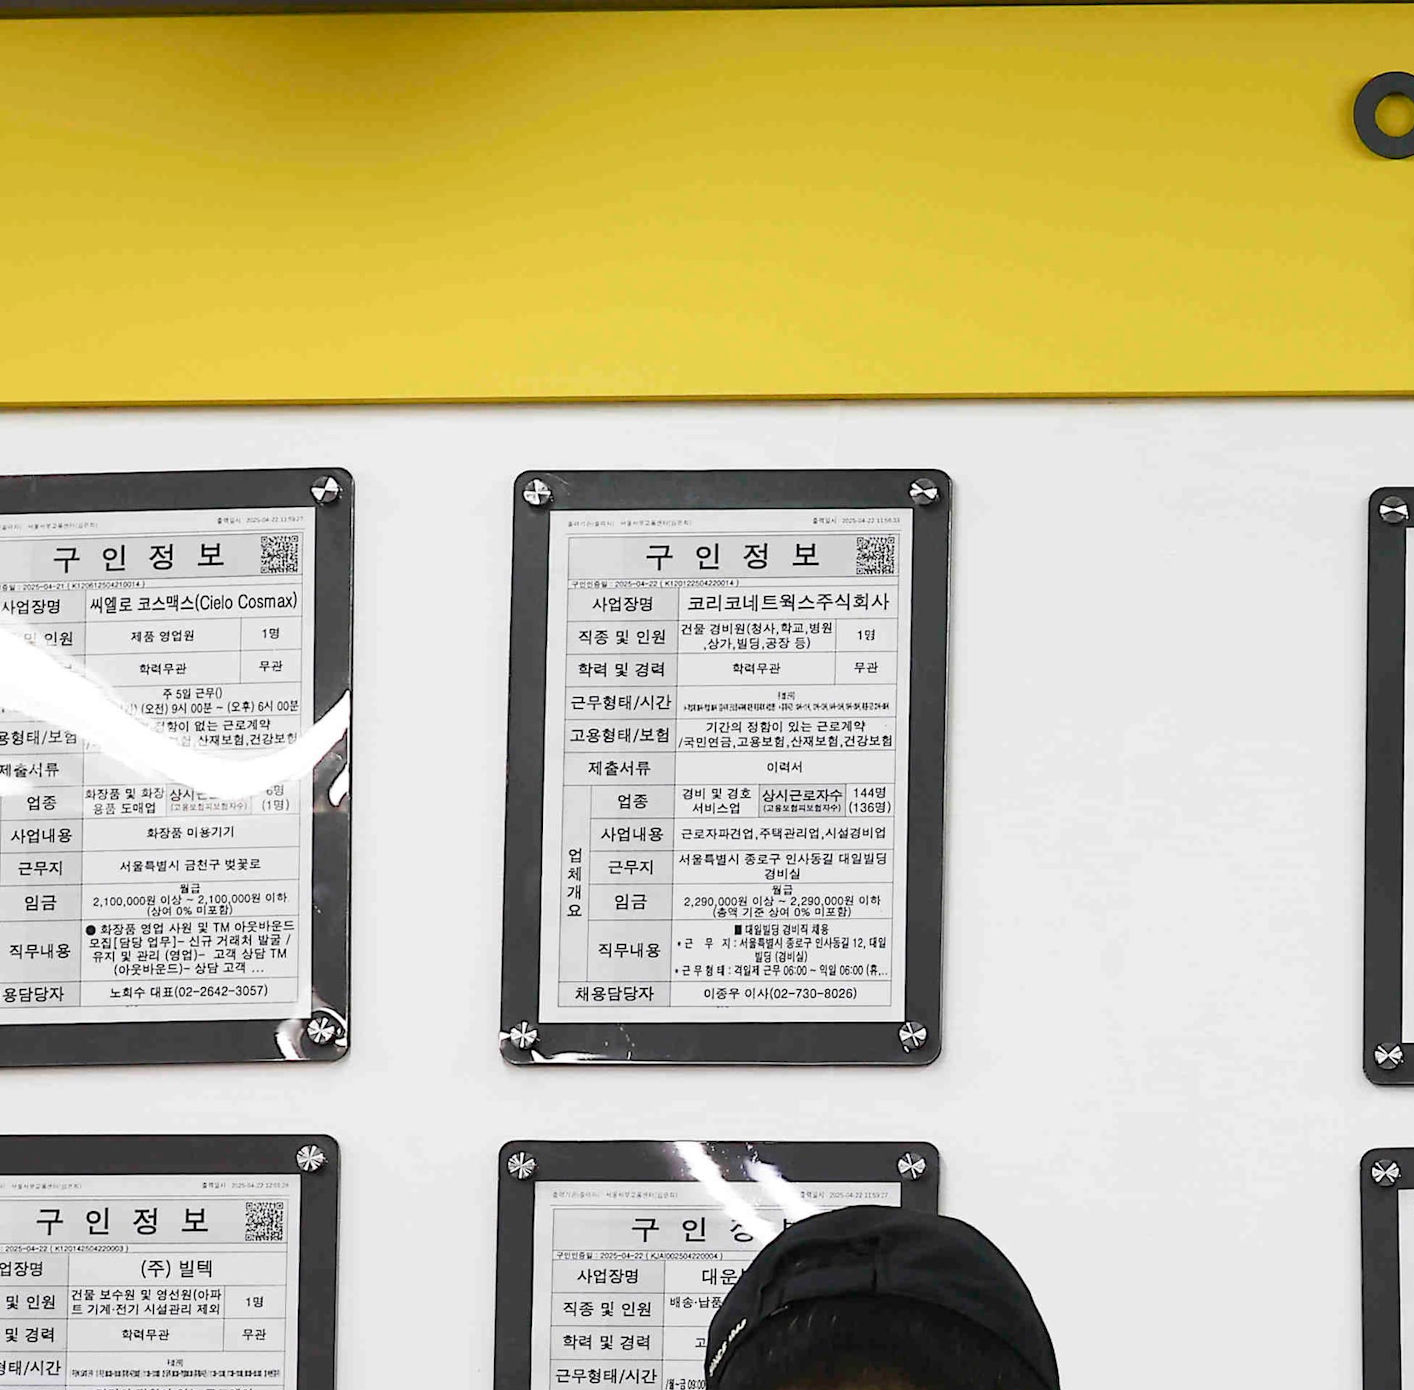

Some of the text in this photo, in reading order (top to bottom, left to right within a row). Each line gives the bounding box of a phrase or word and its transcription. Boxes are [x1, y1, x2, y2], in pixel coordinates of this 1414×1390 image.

[2, 598, 61, 615] 사업장명
[89, 591, 298, 614] 씨엘로 코스맥스(Cielo Cosmax)
[592, 596, 653, 613] 사업장명
[130, 629, 195, 643] 제품 영업원
[578, 628, 666, 646] 직종 및 인원
[570, 694, 672, 711] 근무형태/시간
[766, 760, 803, 774] 이력서
[762, 788, 843, 803] 상시근로자수
[853, 786, 886, 799] 144명
[146, 825, 234, 840] 화장품 미용기기
[119, 858, 262, 873] 서울특별시 금천구 벚꽃로
[678, 852, 887, 866] 서울특별시 종로구 인사동길 대일빌딩
[575, 985, 655, 1002] 채용담당자
[141, 1259, 212, 1279] (주) 빌텍
[577, 1268, 639, 1285] 사업장명
